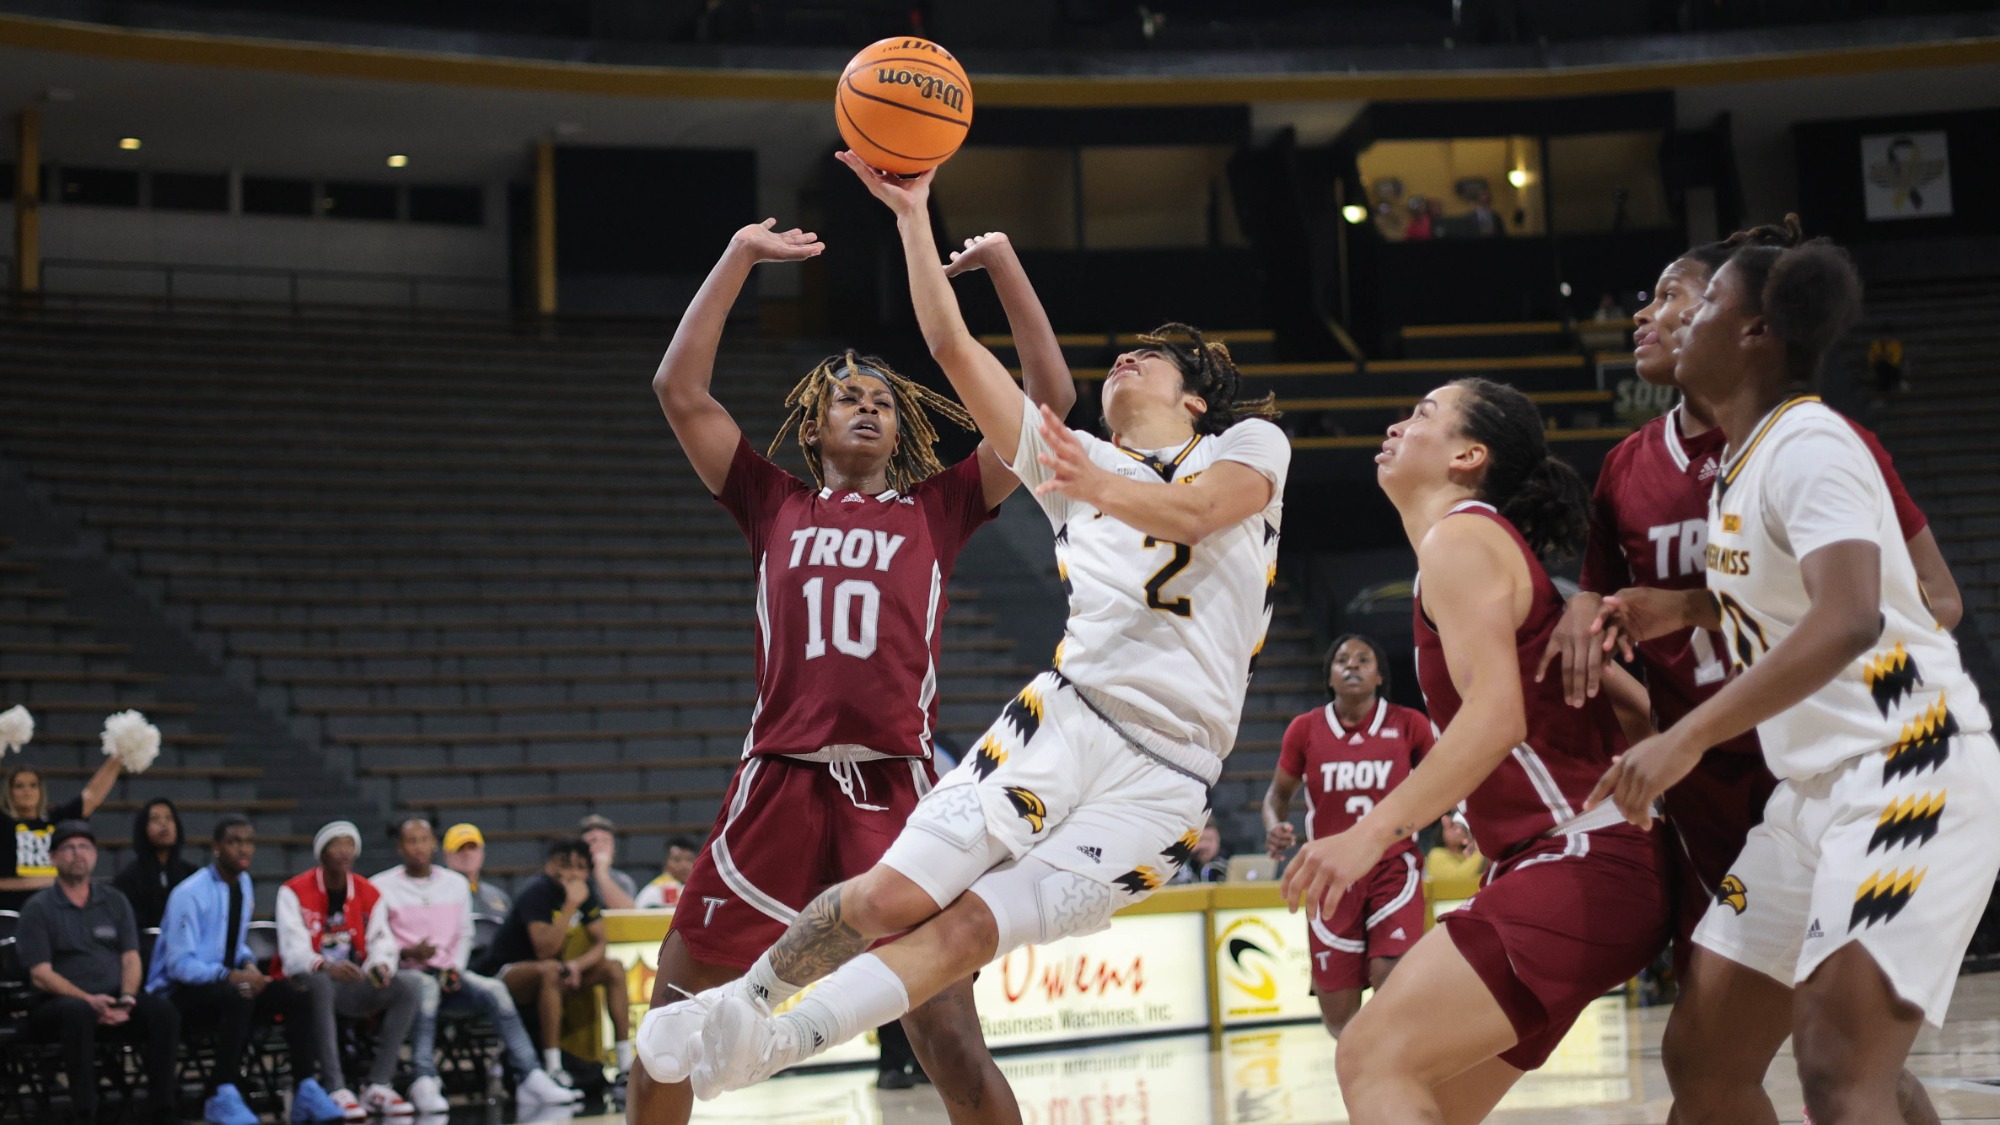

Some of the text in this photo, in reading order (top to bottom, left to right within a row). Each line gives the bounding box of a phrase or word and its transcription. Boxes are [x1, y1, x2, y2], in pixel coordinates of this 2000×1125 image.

[877, 68, 964, 113] Wilson
[1614, 379, 1674, 414] SOU
[788, 526, 906, 572] TROY
[1648, 518, 1709, 580] TR
[1142, 534, 1192, 619] 2
[802, 576, 881, 660] 10
[1320, 760, 1394, 793] TROY
[702, 896, 728, 928] T
[1001, 943, 1147, 1004] Owens
